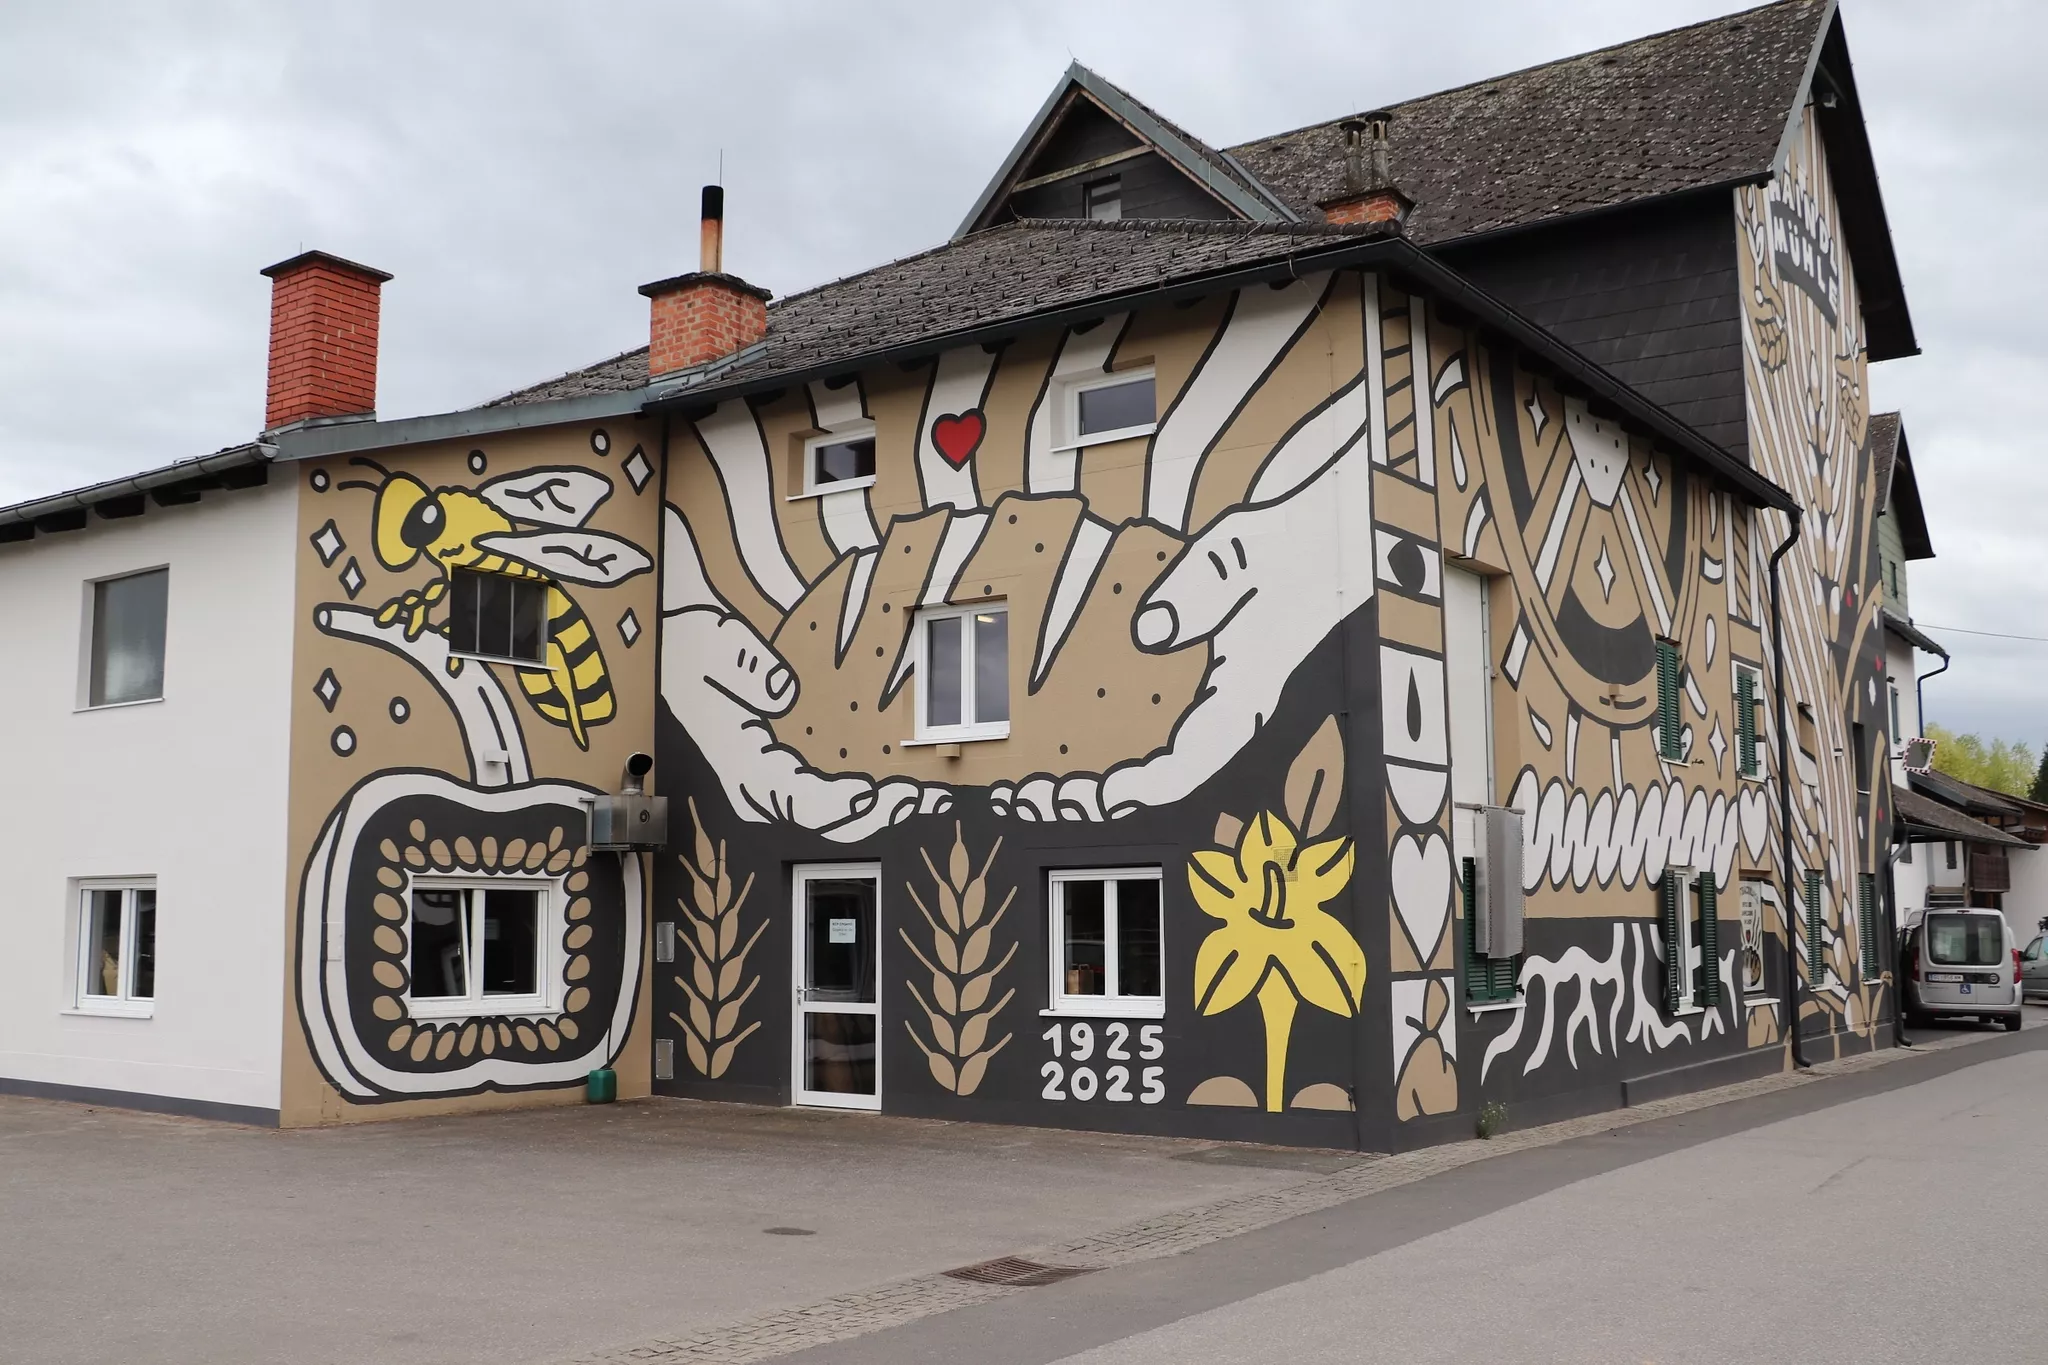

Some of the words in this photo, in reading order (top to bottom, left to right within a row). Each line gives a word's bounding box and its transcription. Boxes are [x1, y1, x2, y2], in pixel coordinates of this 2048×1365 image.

[1773, 215, 1838, 316] MÜHLE
[1042, 1023, 1164, 1061] 1925
[1041, 1061, 1166, 1104] 2025
